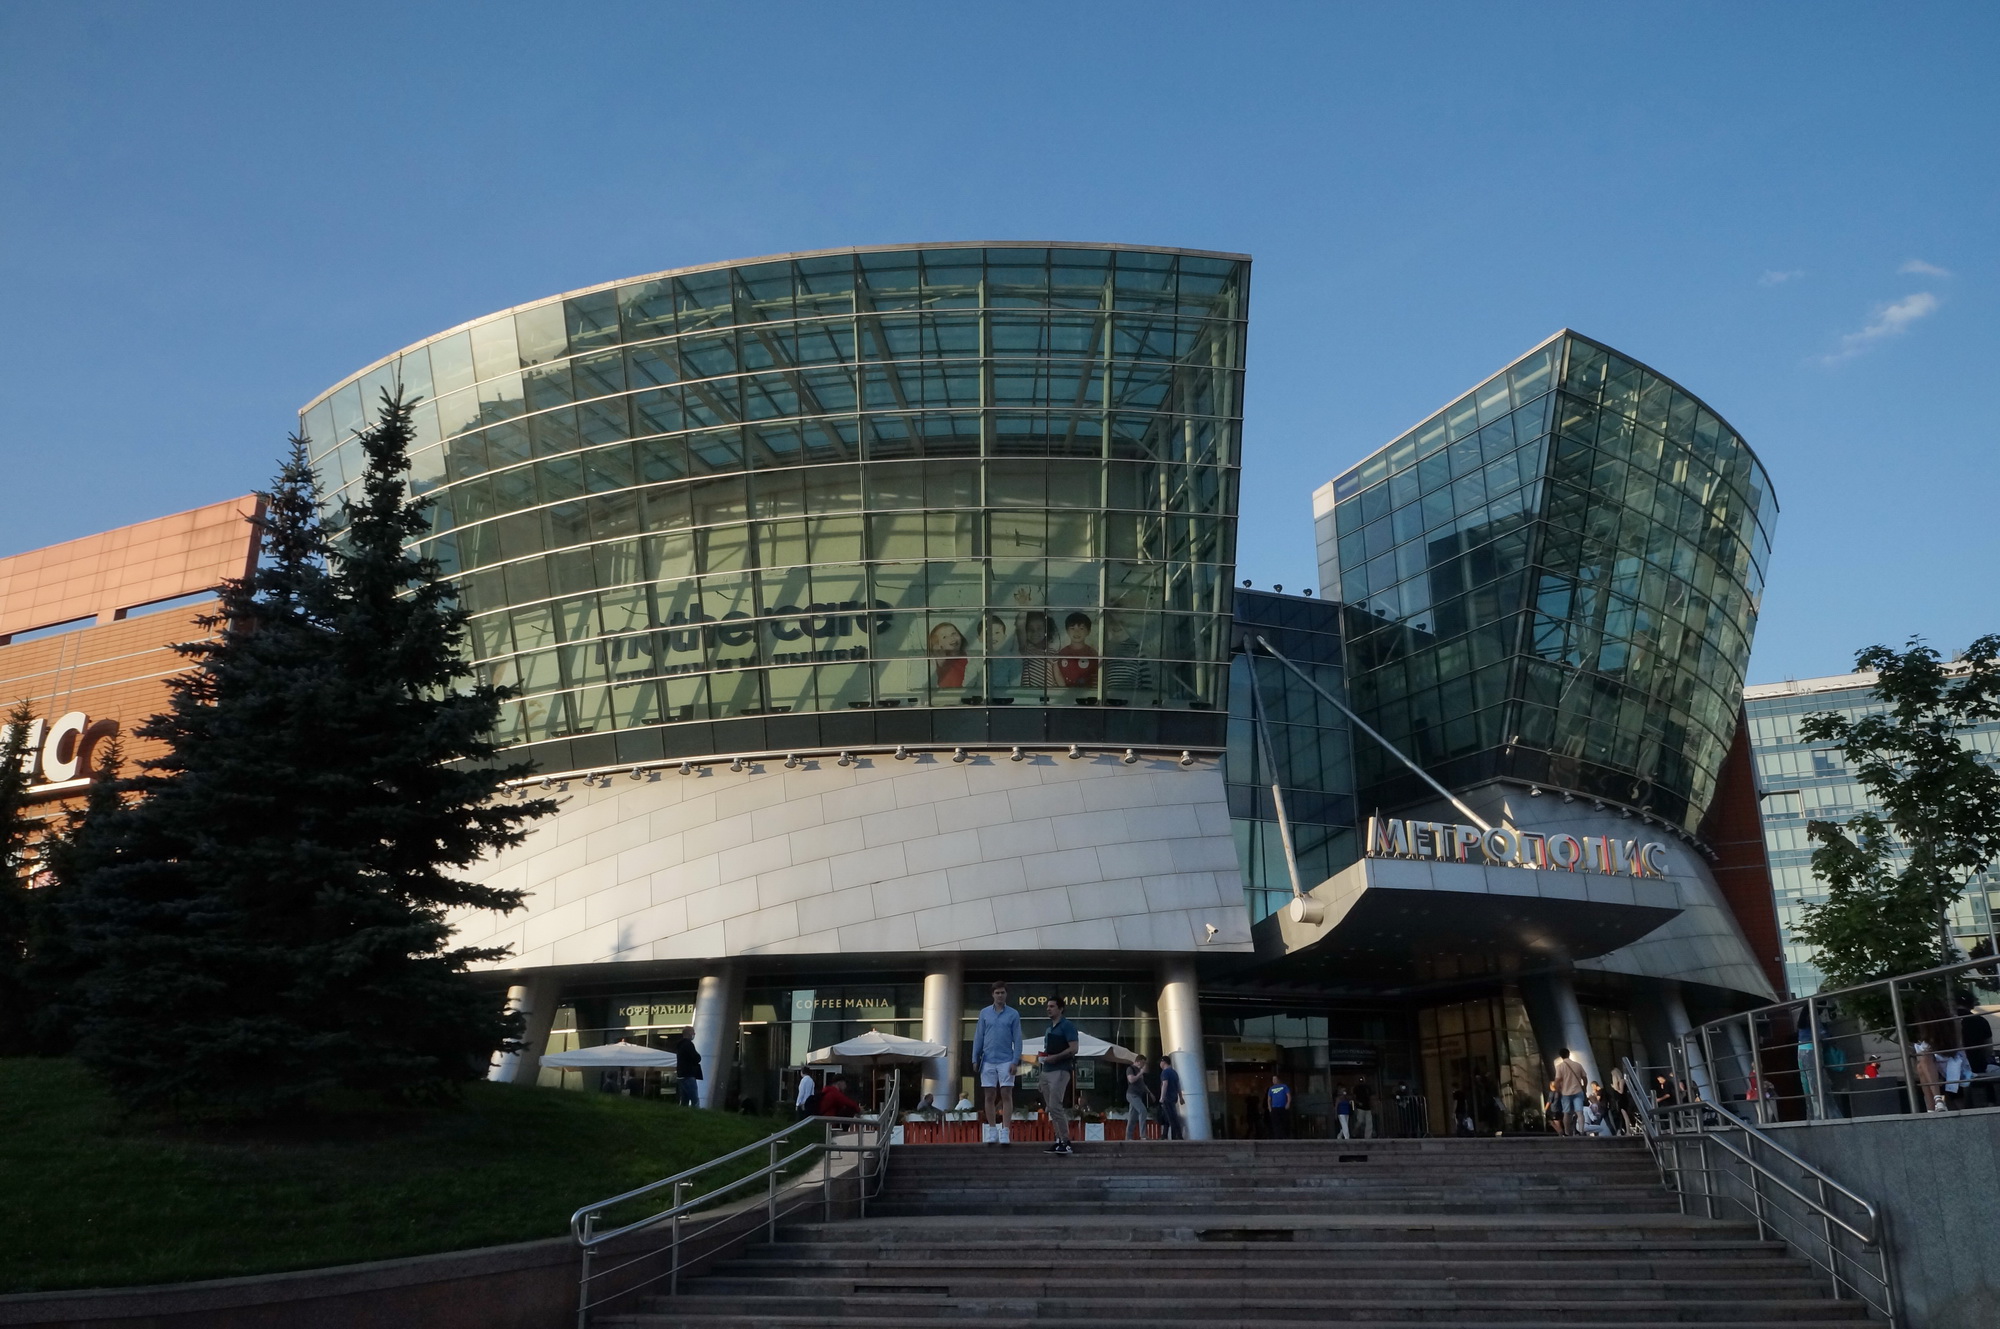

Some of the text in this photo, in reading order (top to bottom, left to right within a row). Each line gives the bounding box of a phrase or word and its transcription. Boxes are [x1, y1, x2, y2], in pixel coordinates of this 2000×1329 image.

[738, 644, 867, 673] МЛЫШЕЙ
[1366, 812, 1667, 878] МЕТРОПОЛИС
[618, 1004, 694, 1016] КОФЕМАНИЯ
[1018, 996, 1110, 1006] КОФАНИЯ
